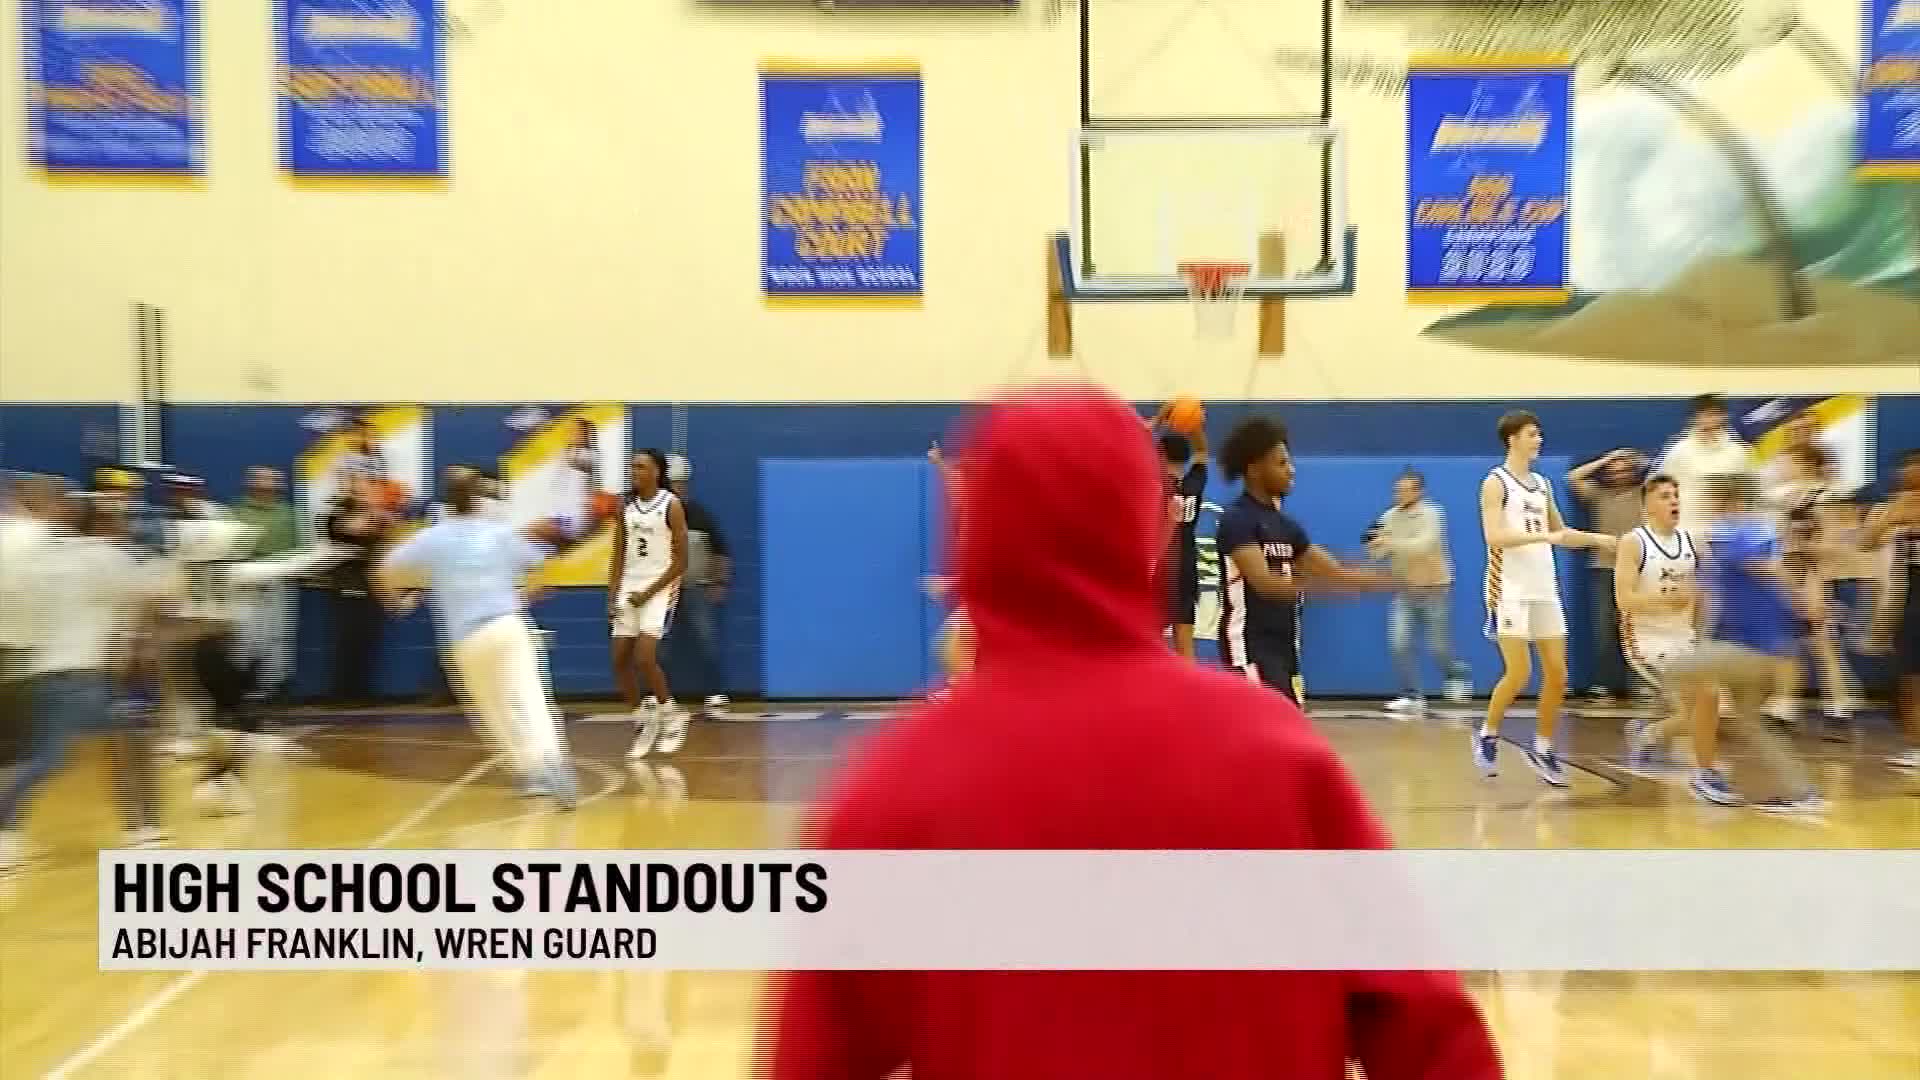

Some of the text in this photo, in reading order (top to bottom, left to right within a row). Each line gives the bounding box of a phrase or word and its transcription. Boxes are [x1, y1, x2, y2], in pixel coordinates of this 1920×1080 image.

[794, 226, 889, 260] COURT
[857, 265, 917, 286] SCHOOL
[637, 537, 648, 557] 2
